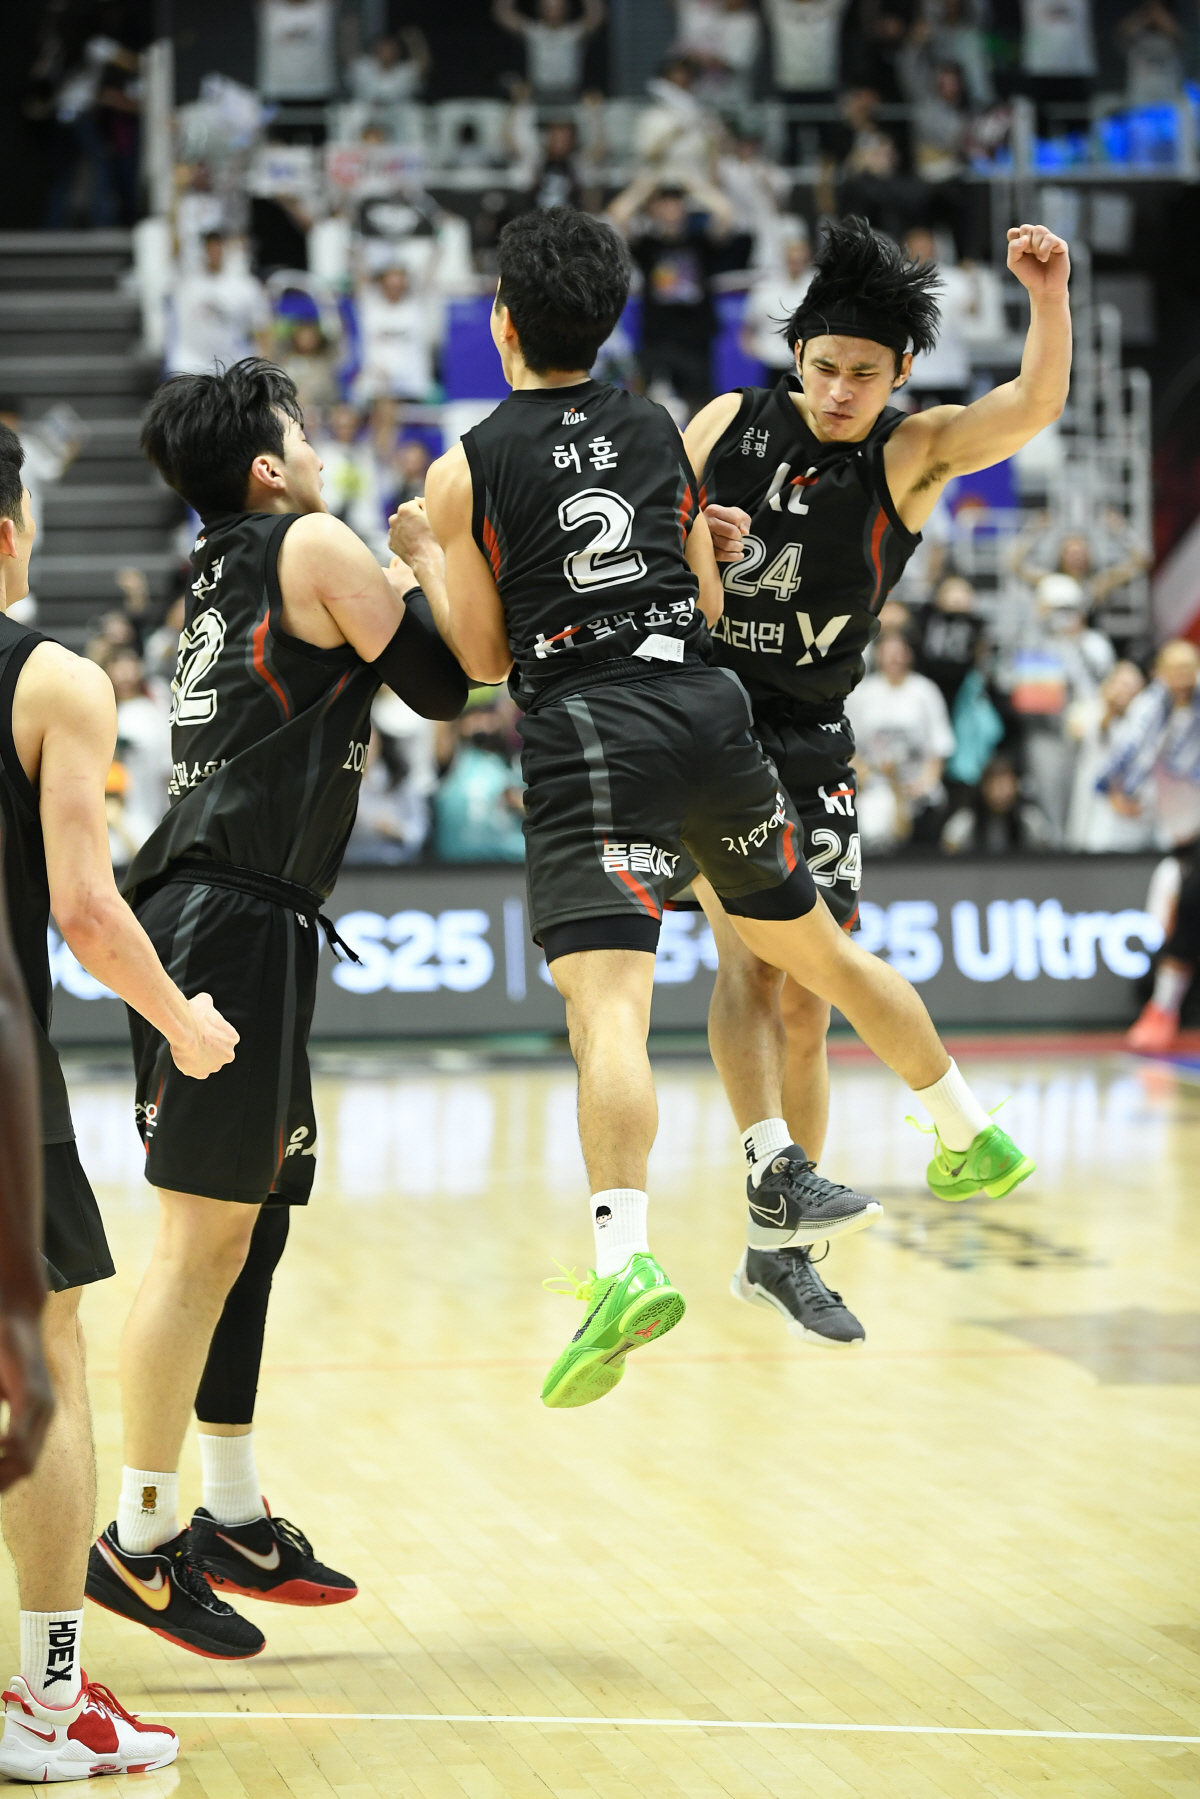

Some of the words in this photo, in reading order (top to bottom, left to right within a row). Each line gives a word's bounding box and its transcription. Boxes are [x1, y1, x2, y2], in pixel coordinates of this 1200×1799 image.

[557, 487, 648, 594] 2
[723, 533, 803, 602] 24
[169, 606, 228, 727] 2
[342, 740, 370, 774] 20
[817, 782, 855, 817] kt
[807, 828, 862, 892] 24
[331, 909, 495, 994] S25
[43, 1619, 78, 1690] HDEX
